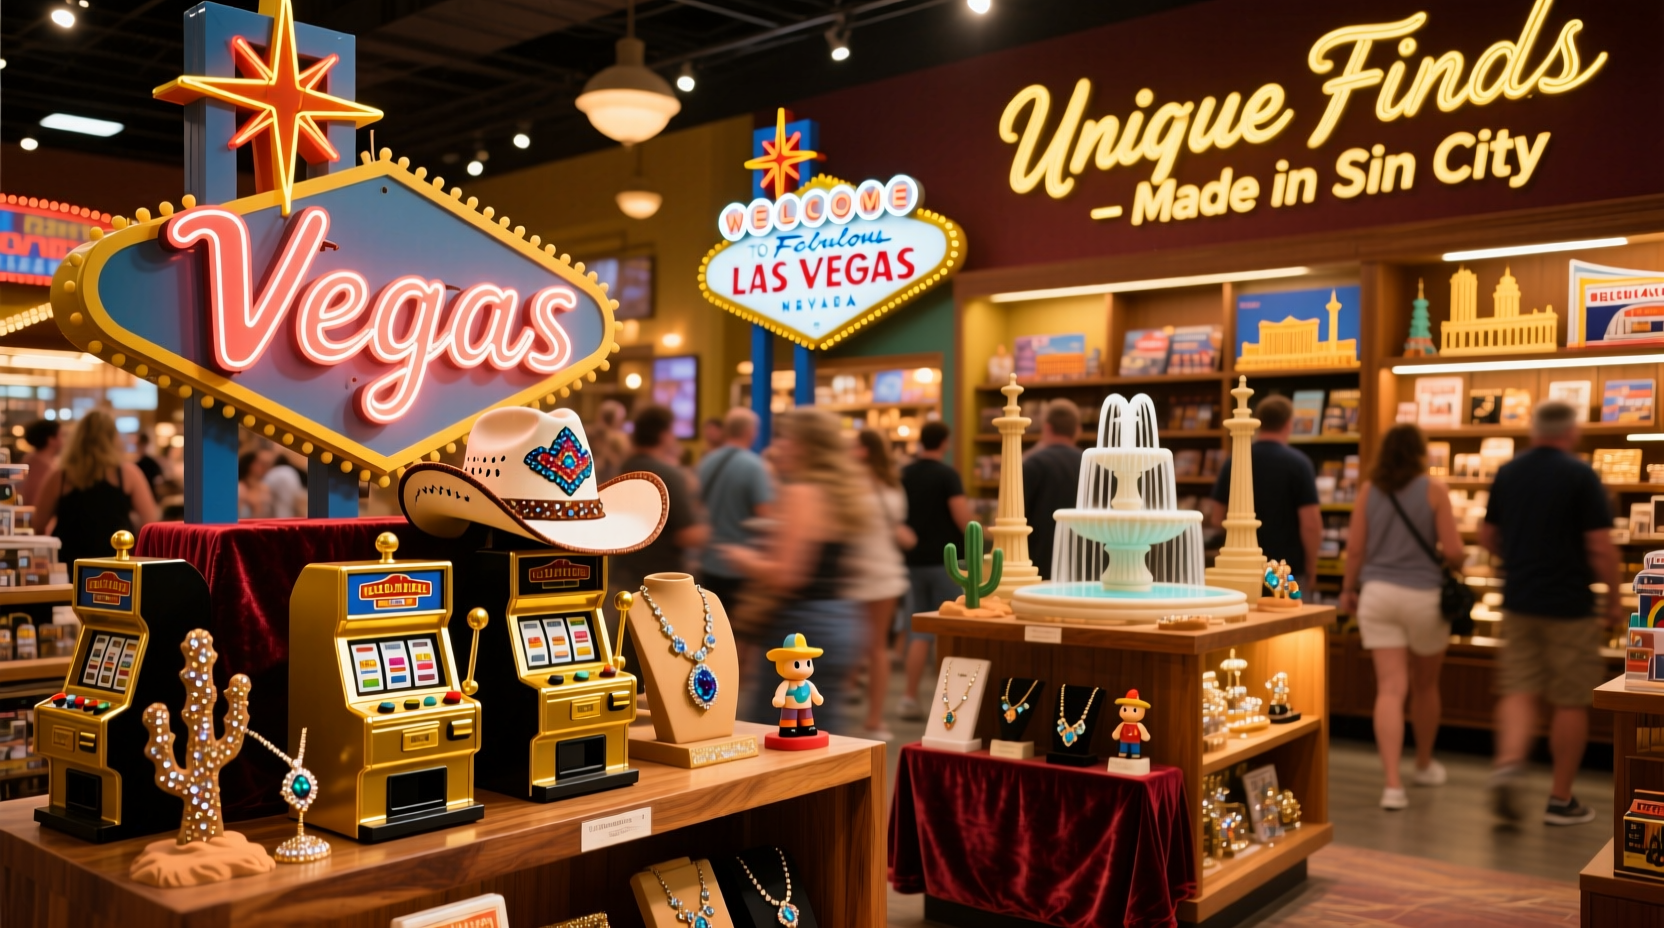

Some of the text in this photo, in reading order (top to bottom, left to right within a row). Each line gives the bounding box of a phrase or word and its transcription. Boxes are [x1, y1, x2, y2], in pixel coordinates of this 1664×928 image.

[999, 0, 1608, 198] Unique Finds
[726, 184, 909, 236] WELCOME
[1130, 166, 1260, 226] Made
[1270, 159, 1318, 208] in
[1331, 144, 1416, 198] Sin
[1432, 128, 1552, 188] City
[732, 247, 916, 295] LAS VEGAS
[748, 243, 769, 257] TO
[165, 204, 578, 424] Vegas
